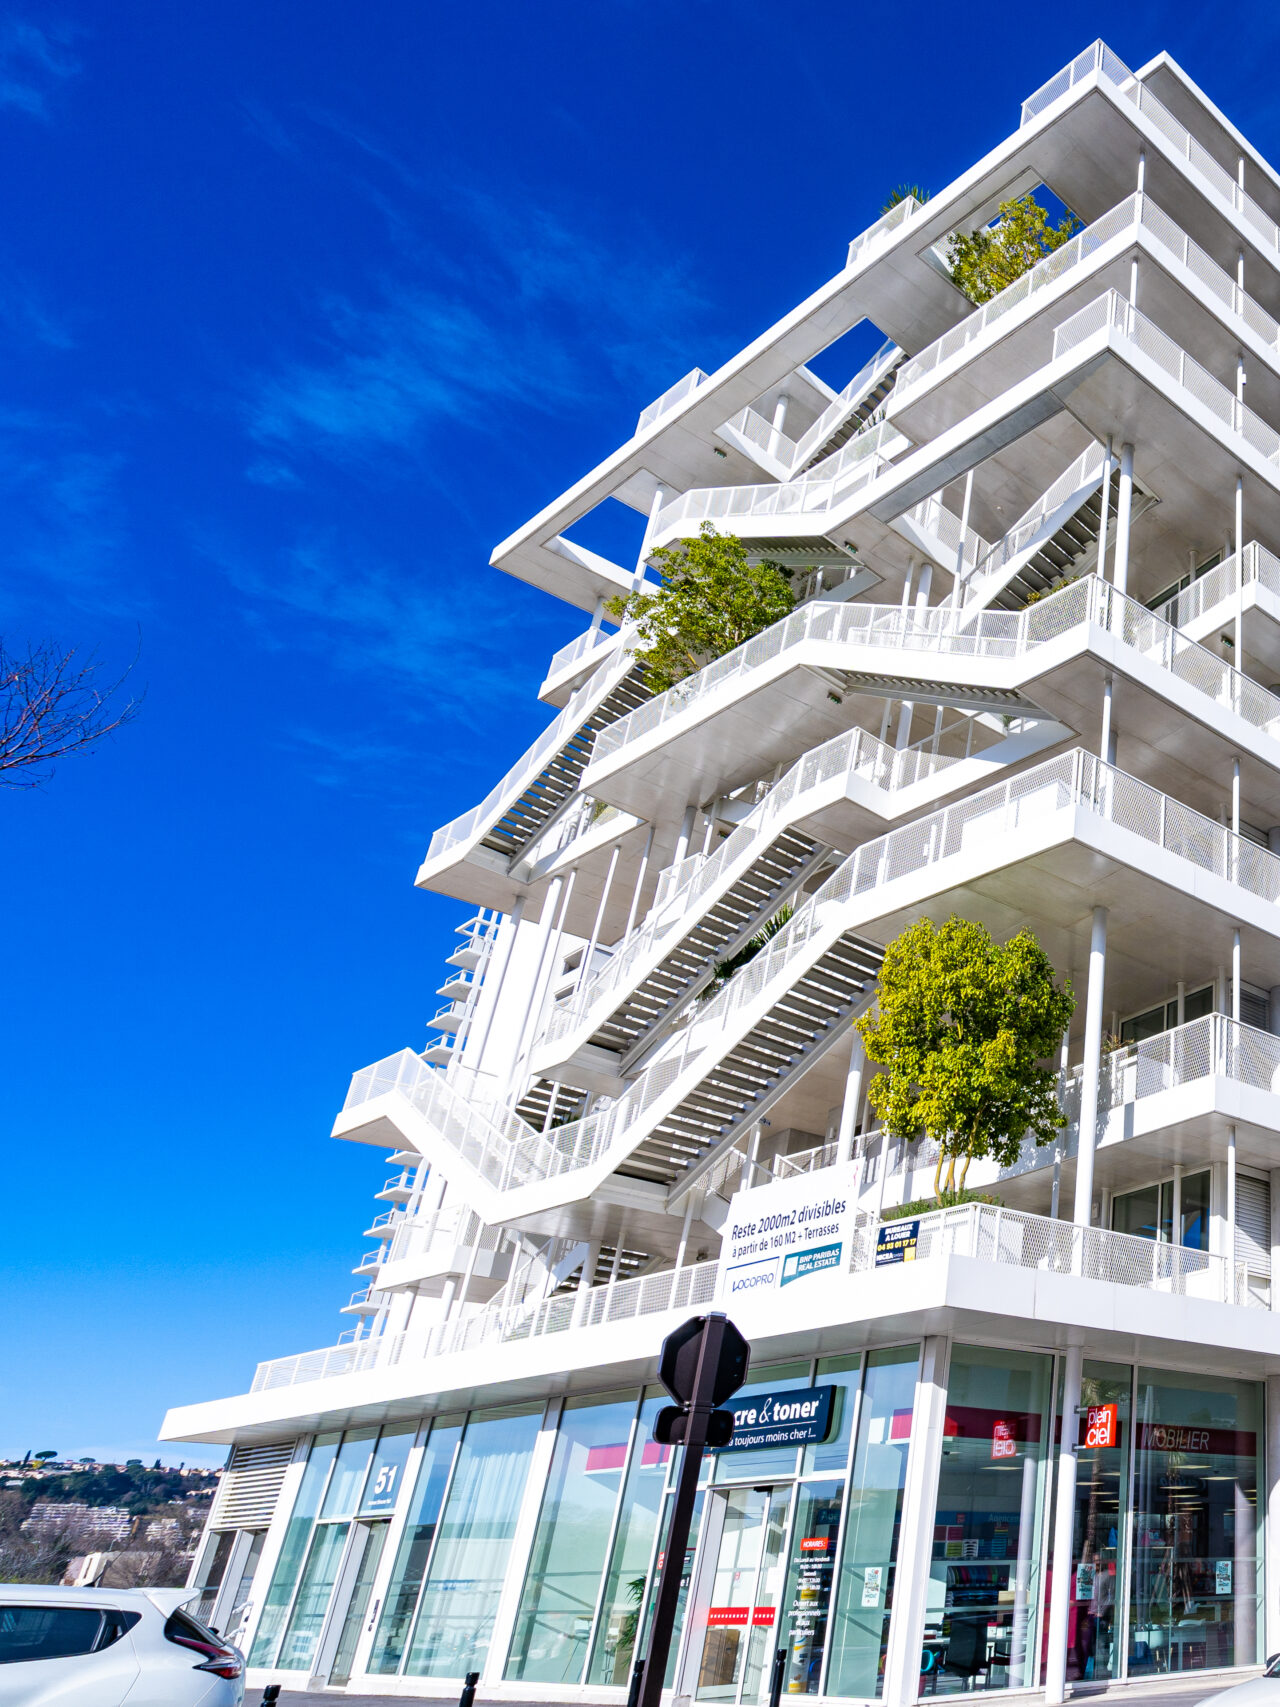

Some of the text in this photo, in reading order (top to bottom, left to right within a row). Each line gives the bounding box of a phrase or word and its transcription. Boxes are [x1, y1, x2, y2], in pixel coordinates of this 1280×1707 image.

[731, 1199, 847, 1241] Reste 2000m2 divisibles
[732, 1245, 737, 1258] à
[737, 1240, 758, 1260] partir
[759, 1237, 769, 1252] de
[770, 1234, 784, 1248] 160
[785, 1231, 797, 1245] M2
[804, 1223, 840, 1240] Terrasses
[798, 1257, 837, 1272] REAL ESTATE
[800, 1248, 840, 1264] BNP PARIBAS
[732, 1272, 774, 1293] LOCOPRO
[759, 1397, 773, 1423] &
[773, 1400, 819, 1421] toner
[1088, 1407, 1112, 1428] plein
[735, 1433, 765, 1448] toujours
[765, 1431, 788, 1443] moins
[789, 1428, 808, 1441] cher
[1086, 1424, 1110, 1446] ciel
[1143, 1427, 1210, 1451] MOBILIER
[374, 1465, 398, 1494] 51
